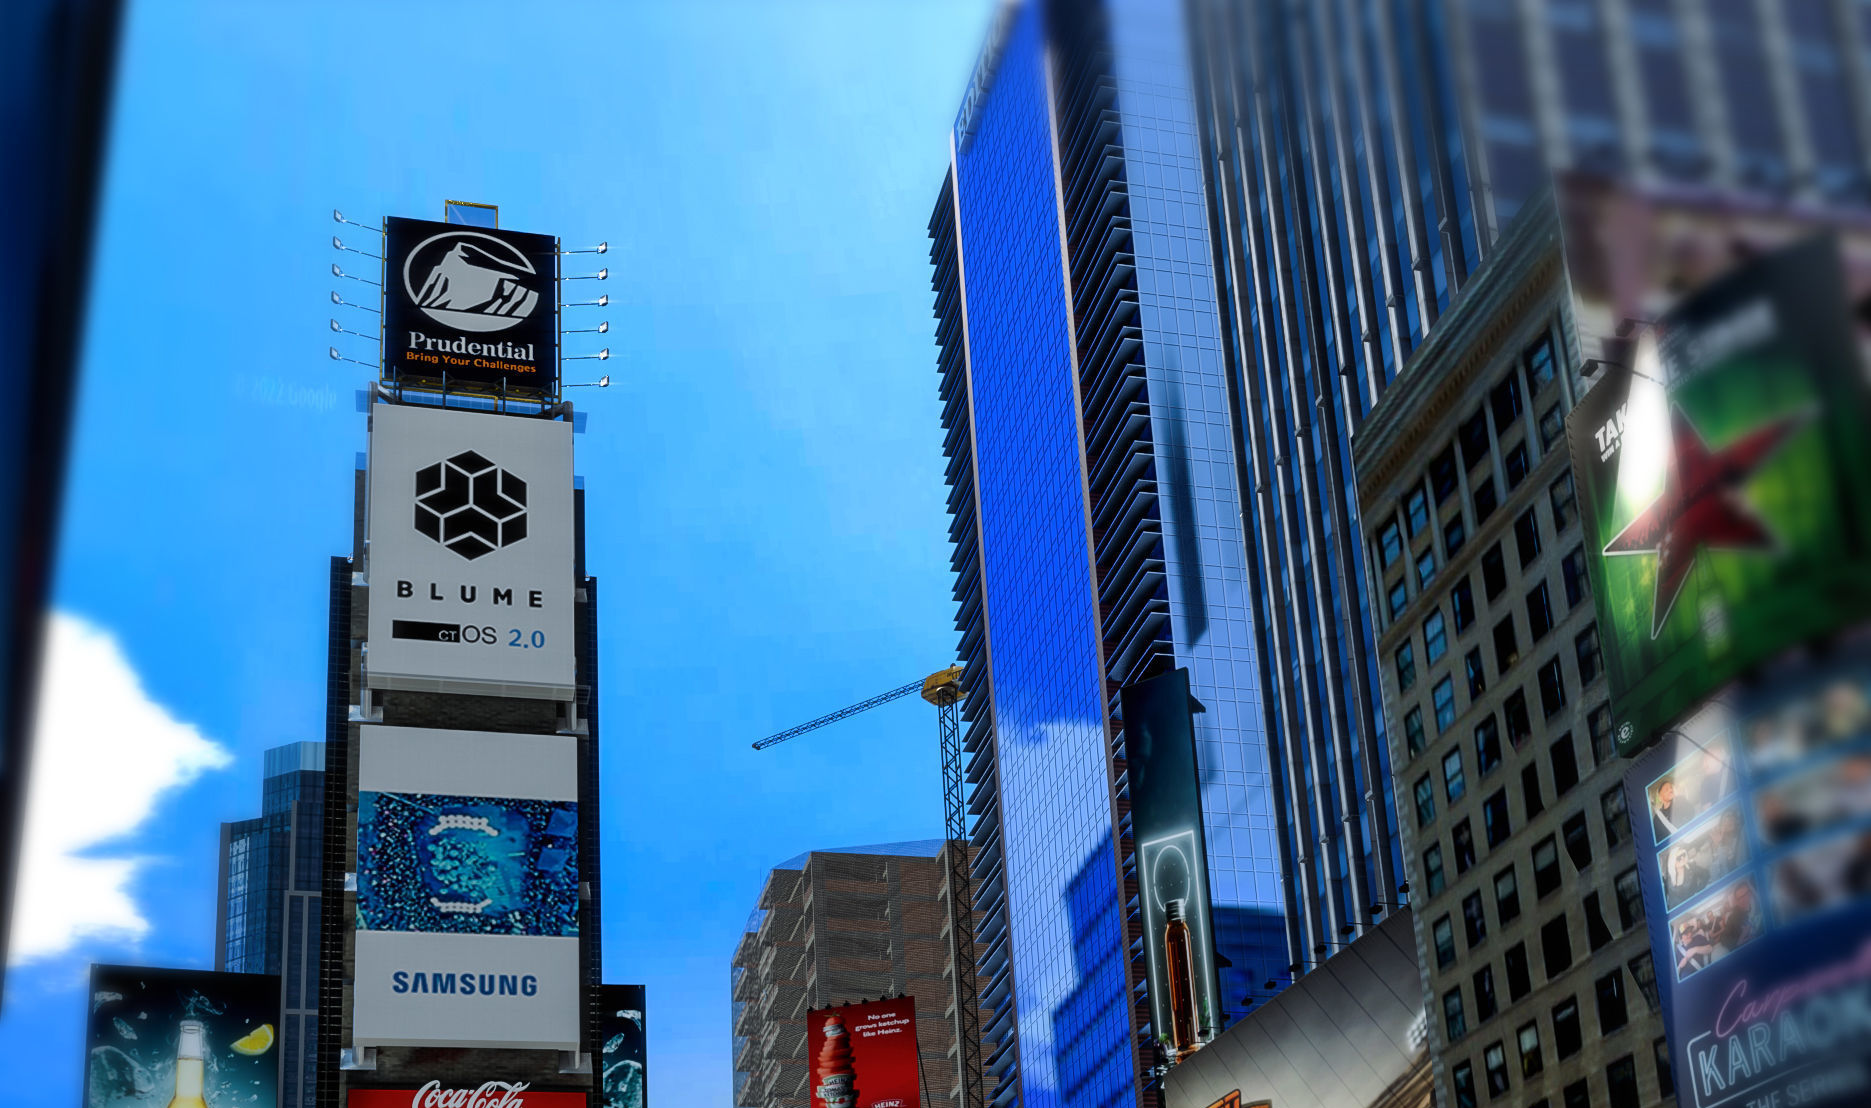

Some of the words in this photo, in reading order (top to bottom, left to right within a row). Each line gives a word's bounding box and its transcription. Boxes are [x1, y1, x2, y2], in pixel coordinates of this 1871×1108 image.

[408, 331, 535, 362] Prudential
[406, 351, 439, 365] Bring
[442, 355, 470, 368] Your
[474, 358, 536, 374] Challenges
[397, 580, 543, 608] BLUME
[508, 629, 545, 649] 2.0
[392, 970, 538, 997] SAMSUNG
[878, 1018, 910, 1028] ketchup
